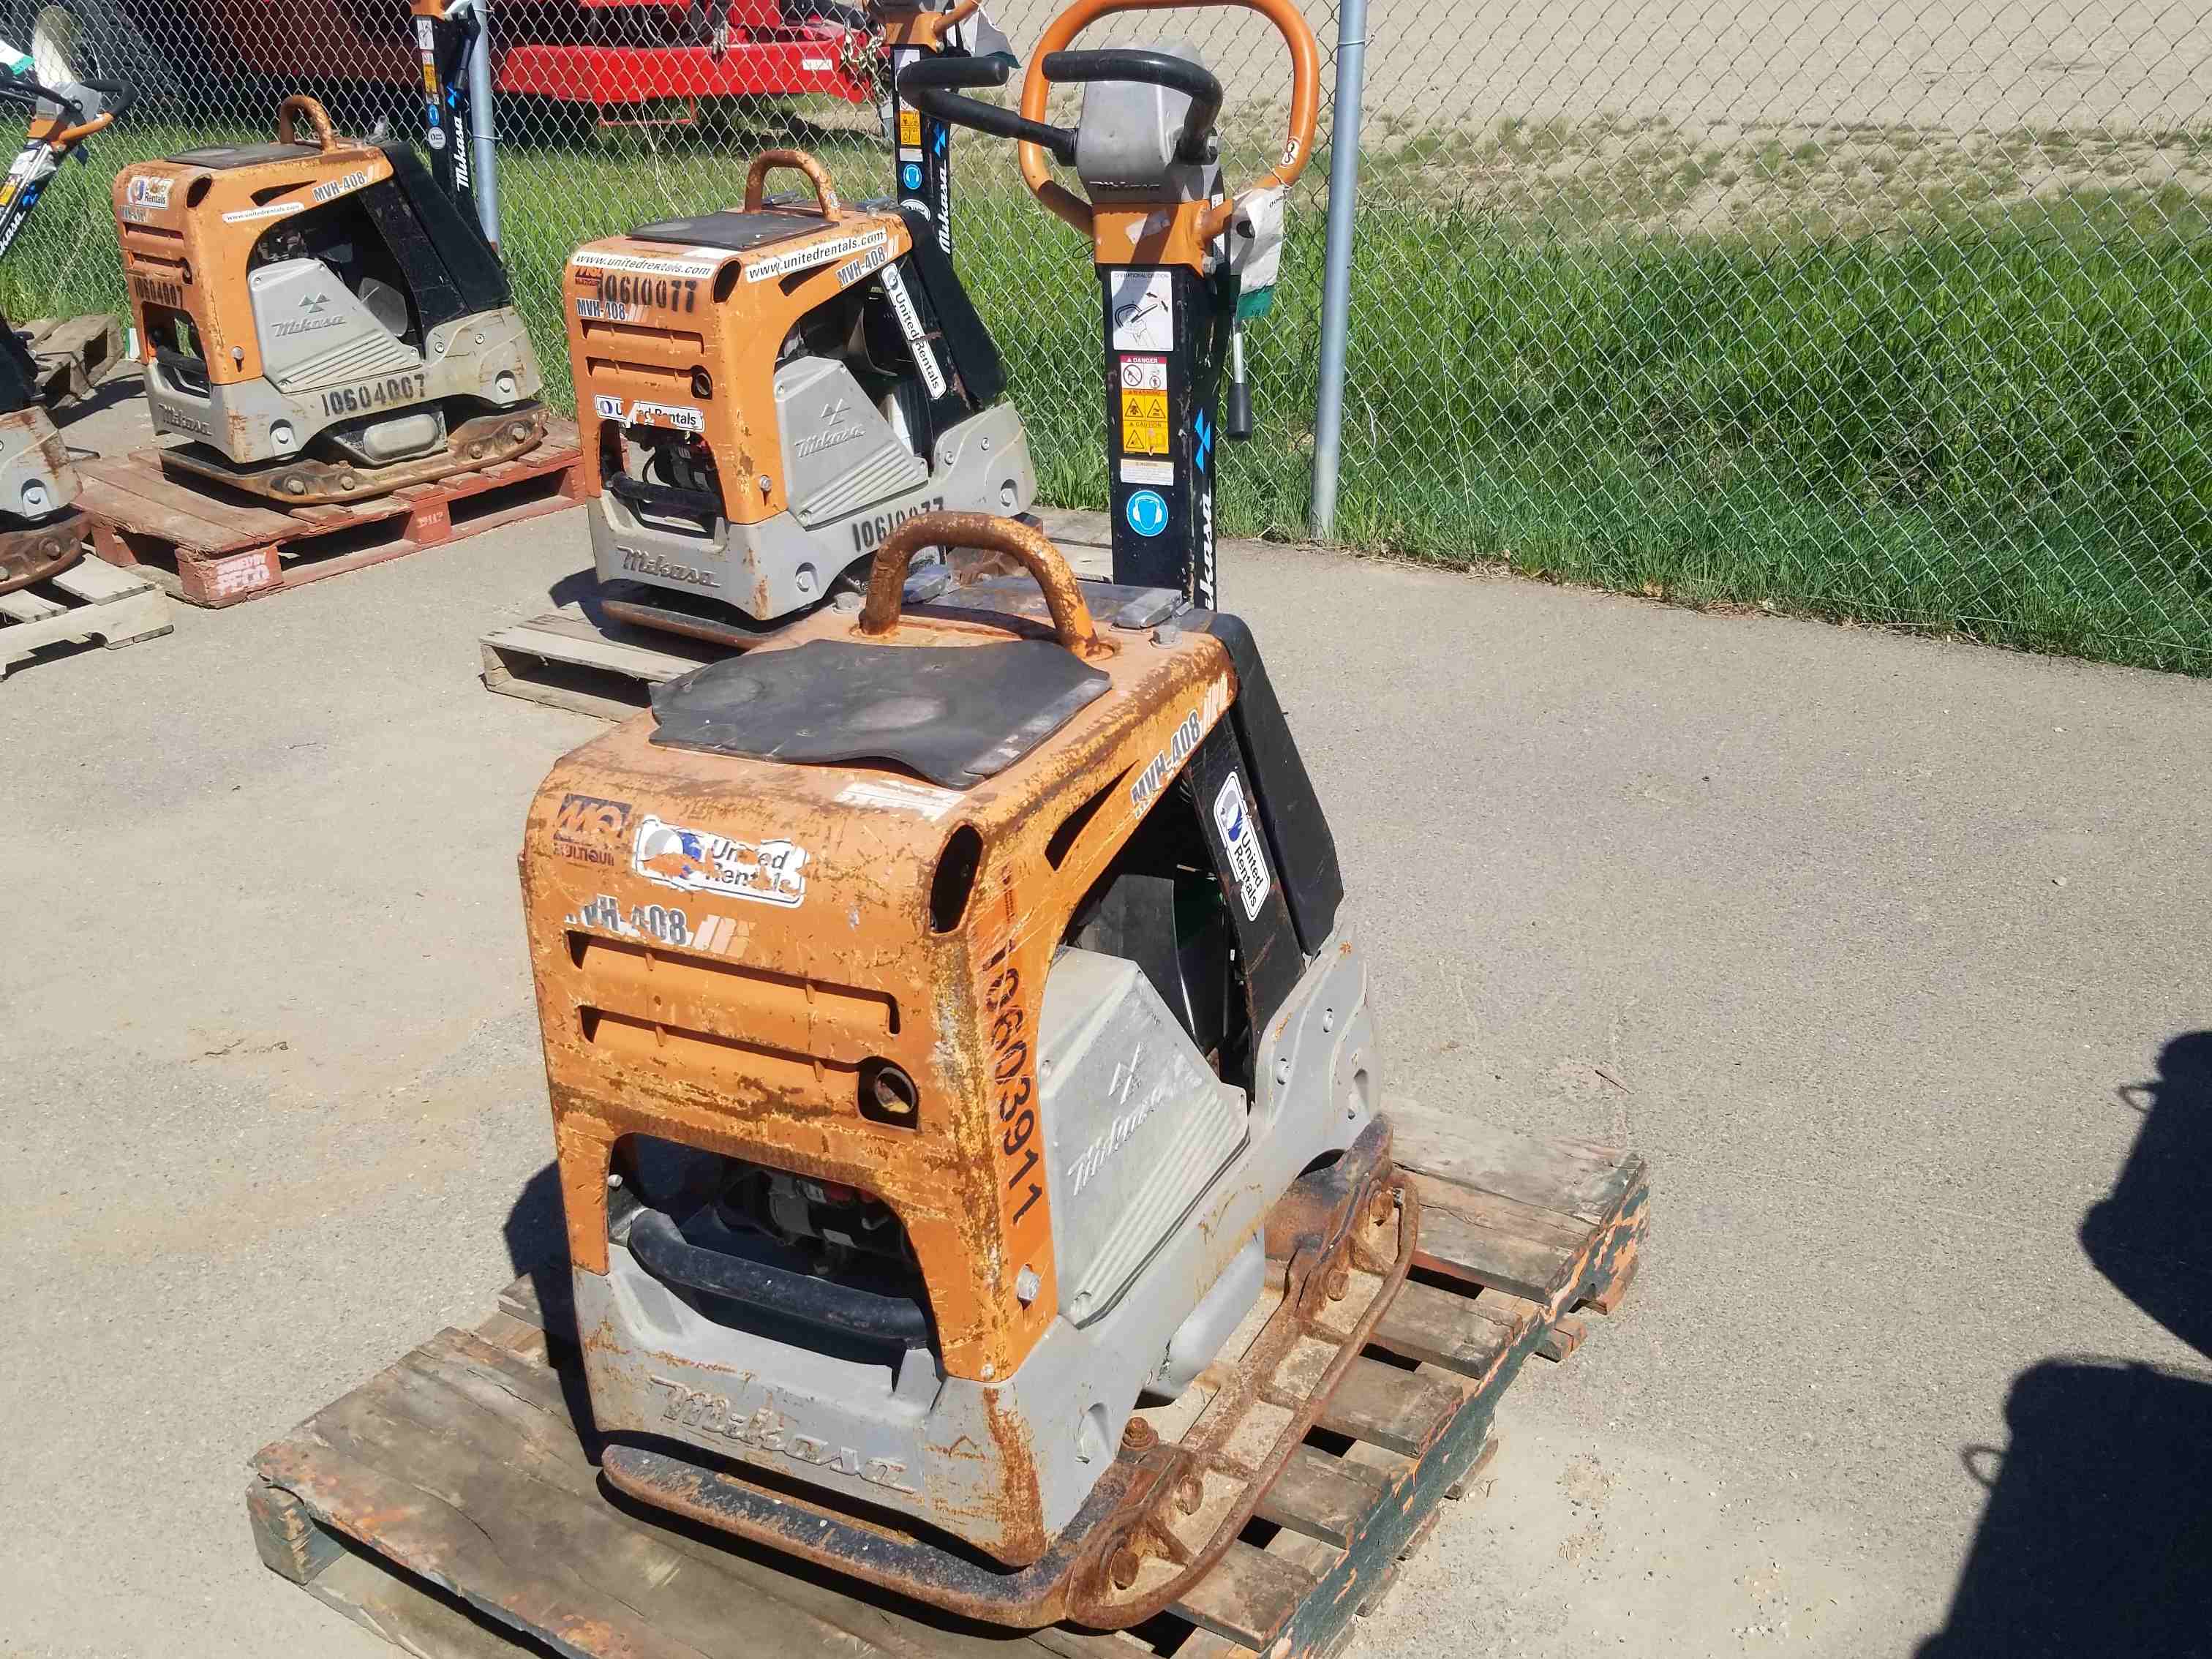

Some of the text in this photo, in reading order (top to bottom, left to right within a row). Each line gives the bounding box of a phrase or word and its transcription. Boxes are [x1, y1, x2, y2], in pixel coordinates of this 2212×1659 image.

[454, 116, 470, 192] Mikasa
[315, 171, 366, 201] MVH-408
[937, 160, 951, 255] Mikasa
[0, 211, 26, 256] kasa
[749, 230, 884, 279] www.unitedrentals.com
[576, 255, 711, 276] www.unitedrentals.com
[837, 245, 885, 287] MVH-408
[577, 298, 626, 320] MVH-408
[597, 274, 697, 313] 10610077
[271, 316, 346, 337] Mikasa
[895, 292, 941, 389] United Rentals
[320, 373, 426, 417] 10604007
[158, 403, 213, 435] Mikasa
[794, 424, 867, 458] Mikasa
[617, 545, 722, 588] Mikasa
[1234, 846, 1257, 907] Rentals
[1241, 831, 1264, 888] United
[982, 938, 1043, 1227] 10603911
[650, 1374, 915, 1494] Mikasa
